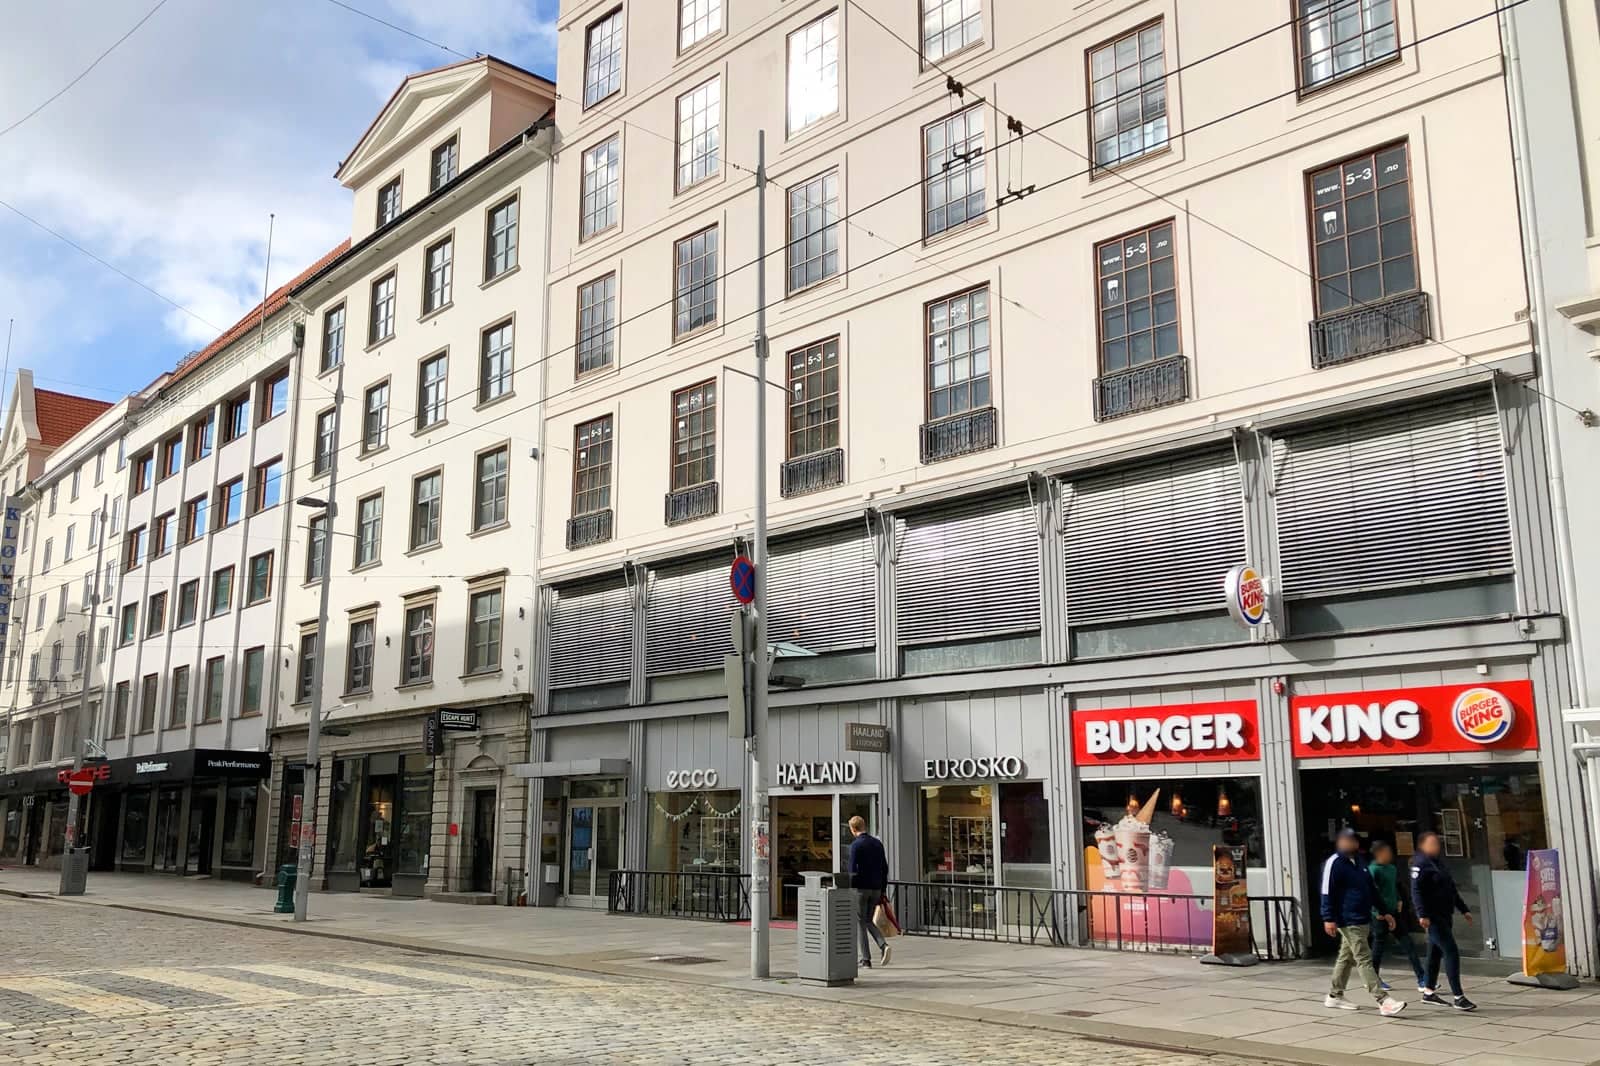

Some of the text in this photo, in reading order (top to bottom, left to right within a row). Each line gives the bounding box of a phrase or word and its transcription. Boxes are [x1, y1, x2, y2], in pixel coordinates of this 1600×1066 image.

[1316, 163, 1399, 196] www. 5-3 .no
[1126, 242, 1147, 258] 5-3
[951, 304, 967, 317] 5-3
[808, 353, 822, 365] 5-3
[690, 393, 703, 405] 5-3
[591, 428, 602, 438] 5-3
[1460, 697, 1499, 720] BURGER
[1463, 705, 1503, 732] KING
[427, 720, 435, 753] GRANIT
[852, 727, 884, 738] HAALAND
[1085, 699, 1420, 754] BURGER KING
[666, 768, 718, 790] ecco
[776, 760, 858, 785] HAALAND
[924, 756, 1022, 780] EUROSKO
